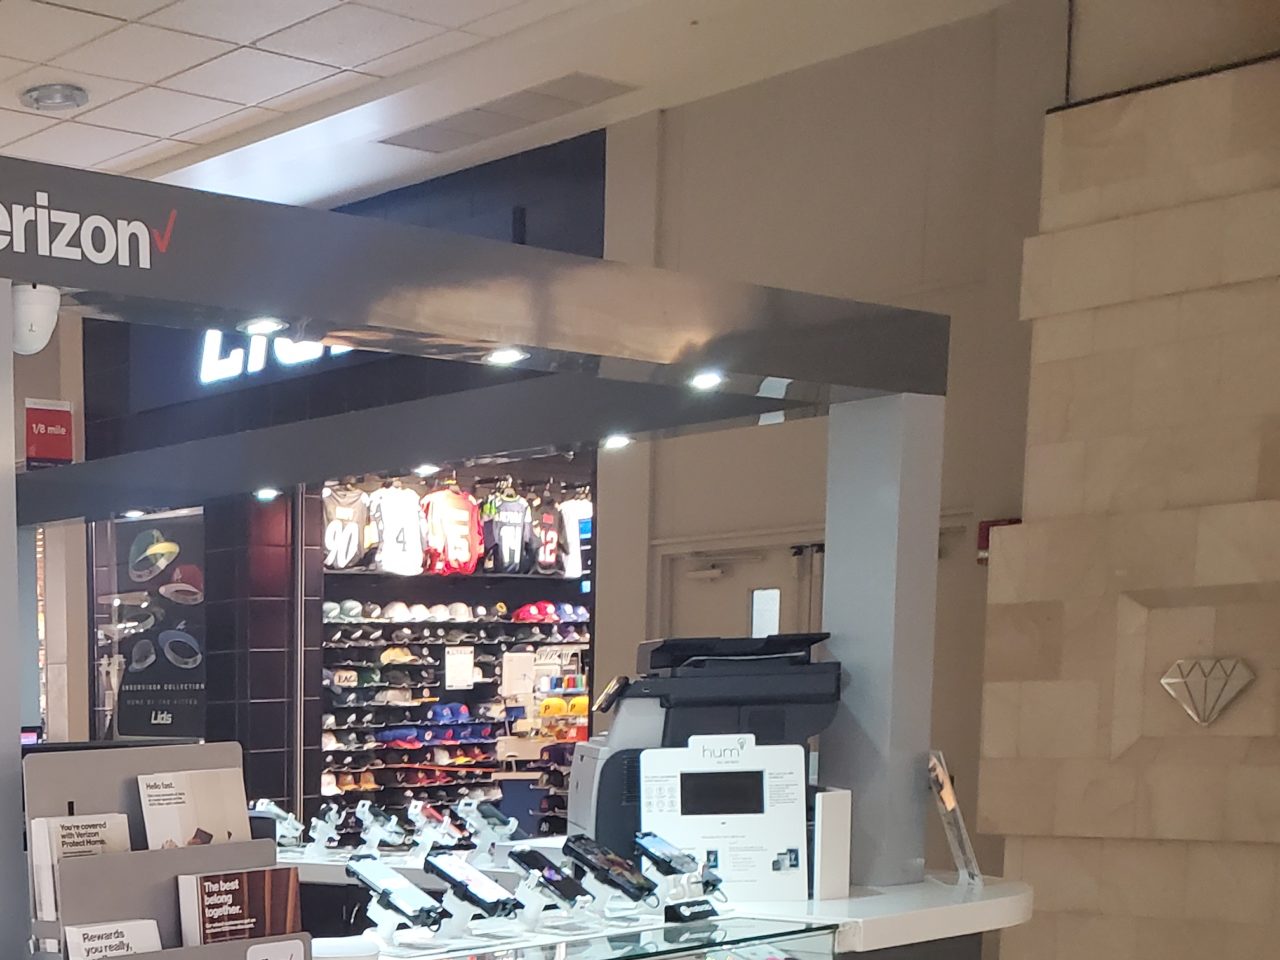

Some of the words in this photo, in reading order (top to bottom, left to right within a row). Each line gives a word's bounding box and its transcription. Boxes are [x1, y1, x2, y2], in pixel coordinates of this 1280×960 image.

[32, 423, 46, 434] 1/8
[47, 424, 67, 435] mile
[150, 710, 173, 724] Lids
[702, 744, 740, 758] hum
[204, 881, 220, 893] The
[220, 879, 239, 891] best
[205, 893, 232, 905] belong
[205, 905, 242, 918] together.
[82, 929, 125, 943] Rewards
[84, 946, 103, 957] you
[104, 940, 132, 953] really,
